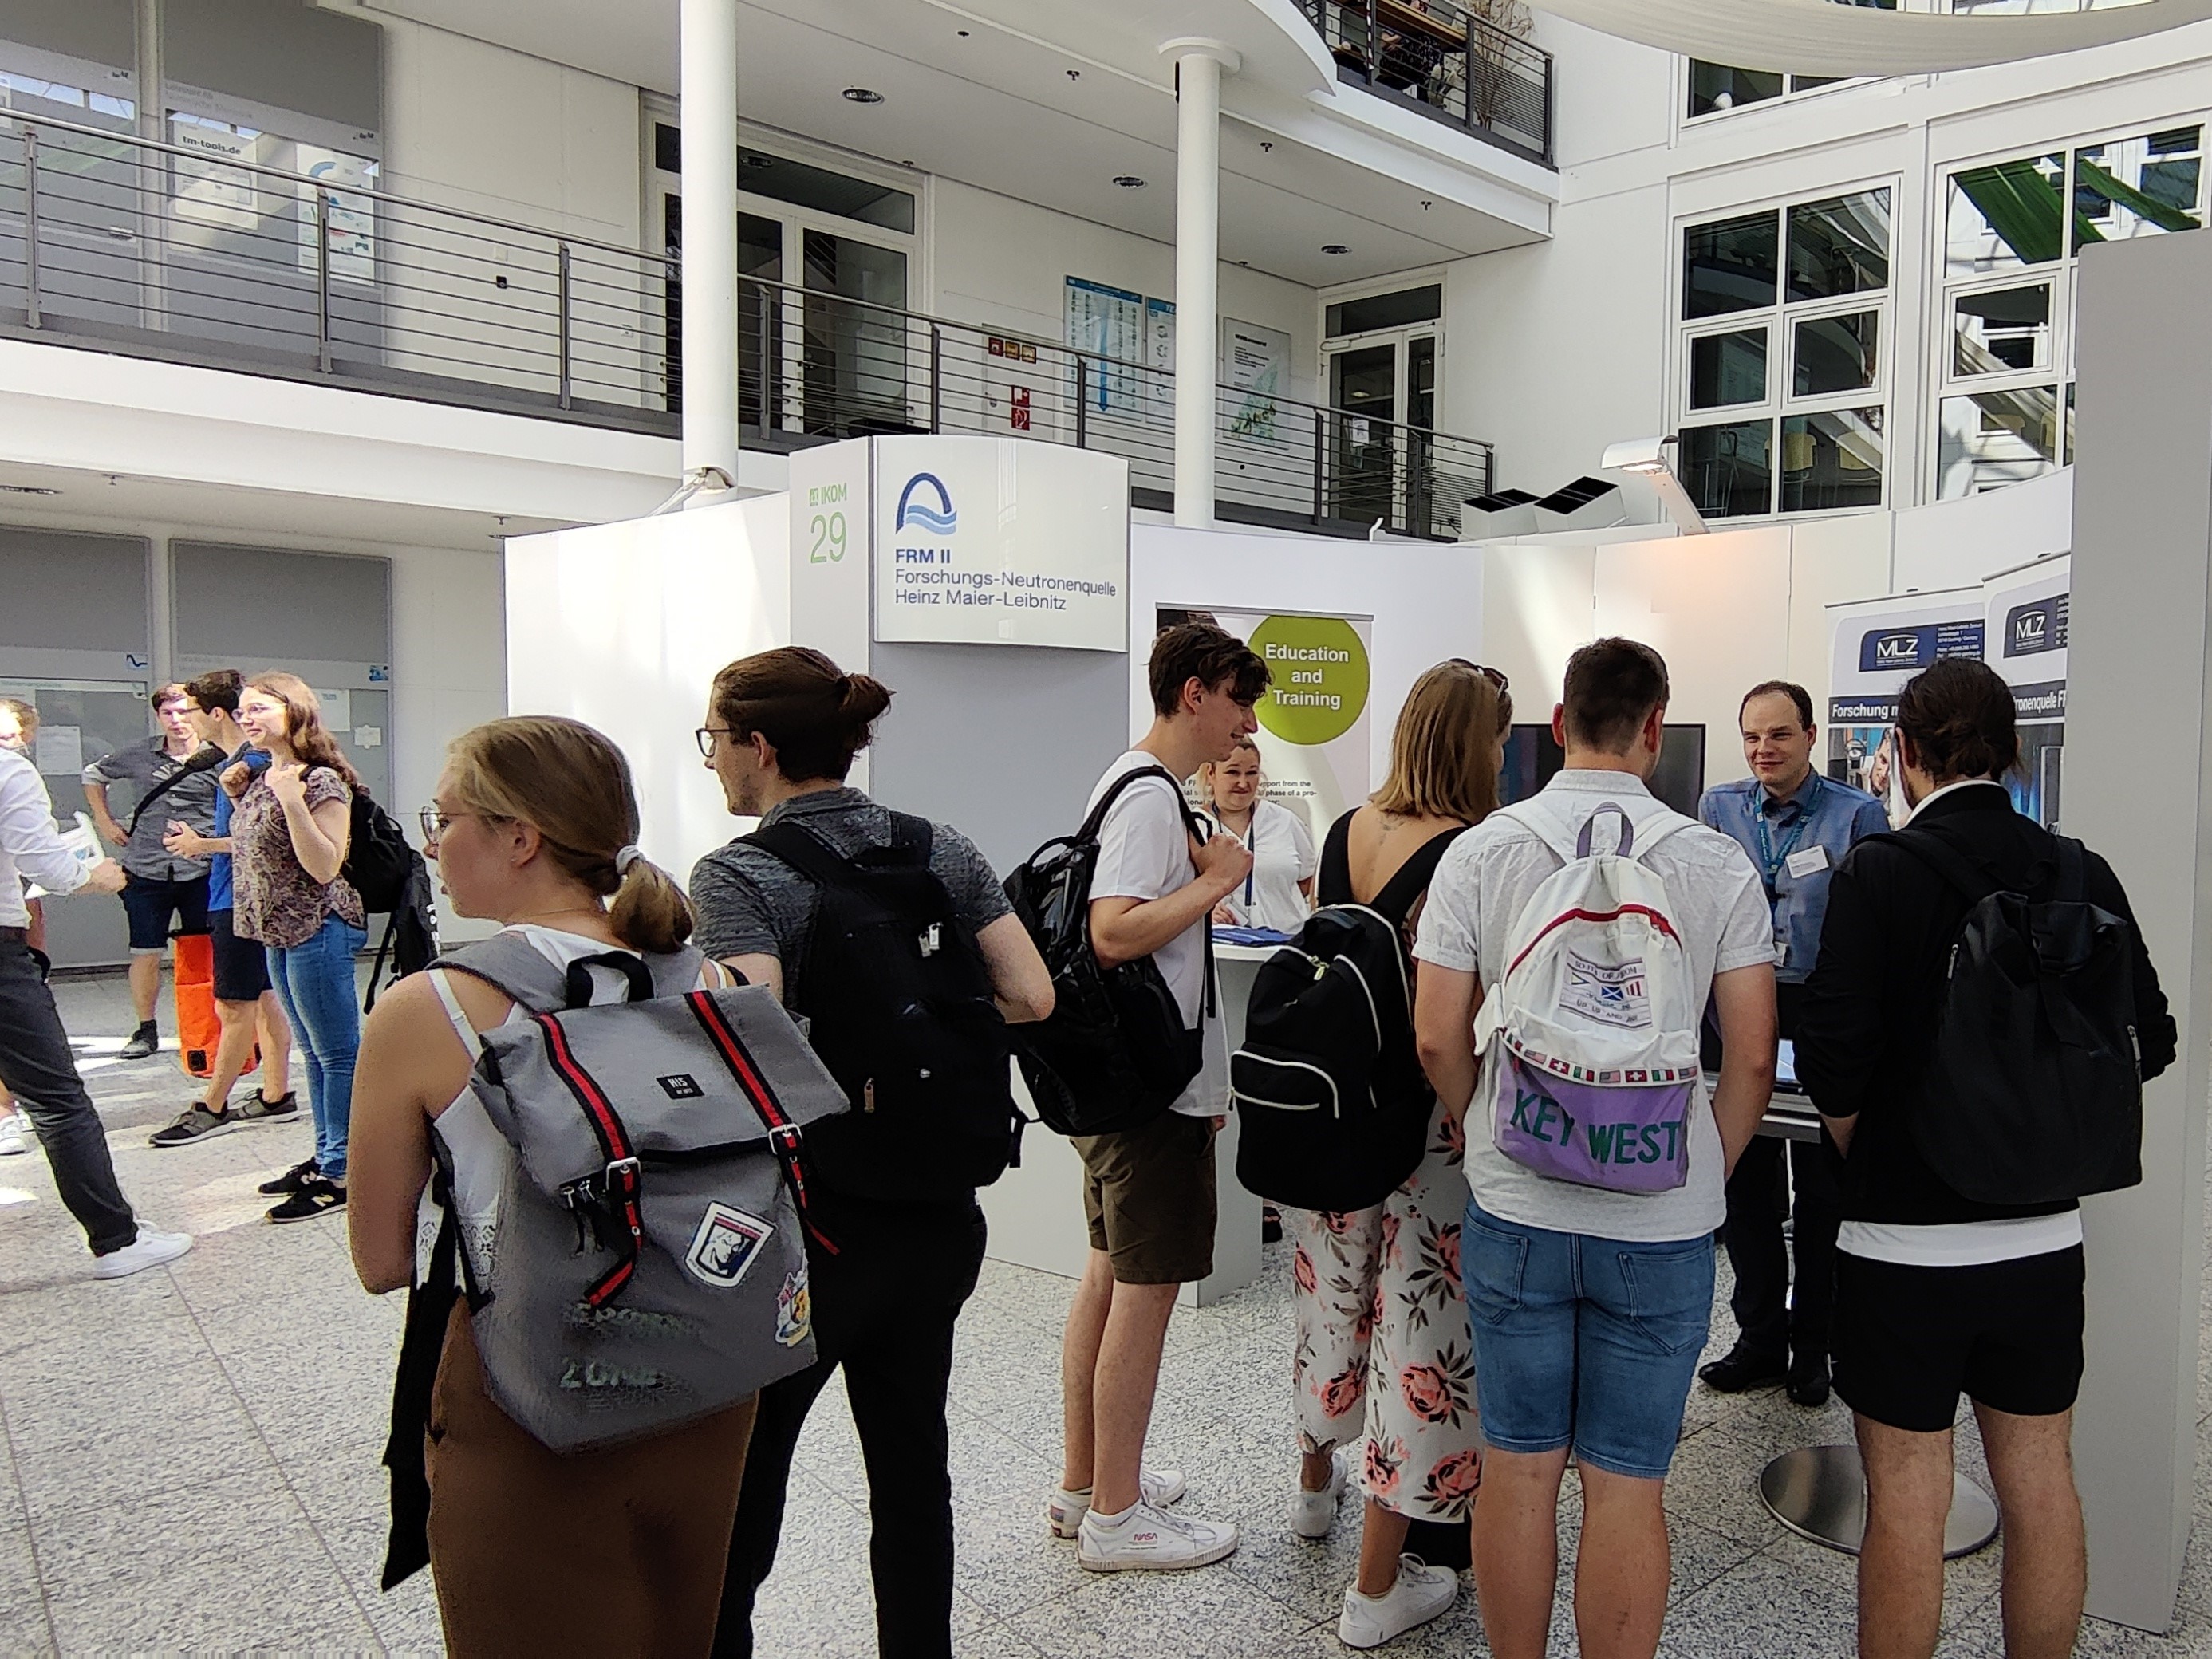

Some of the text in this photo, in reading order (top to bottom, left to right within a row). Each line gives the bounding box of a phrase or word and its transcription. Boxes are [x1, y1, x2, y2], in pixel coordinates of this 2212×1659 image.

[182, 135, 242, 155] tm-tools.de
[821, 482, 847, 505] IKOM
[810, 511, 847, 564] 29
[895, 548, 951, 564] FRM II
[895, 569, 1117, 597] Forschungs-Neutronenquelle
[895, 589, 1067, 611] Heinz Maier-Leibnitz
[2016, 615, 2046, 640] MLZ
[1265, 643, 1350, 663] Education
[1876, 638, 1918, 657] MLZ
[1291, 668, 1323, 684] and
[1272, 689, 1342, 711] Training
[1832, 703, 1889, 719] Forschung
[1265, 789, 1286, 798] phase
[1509, 1088, 1682, 1164] KEY WEST
[1134, 1531, 1158, 1541] NASA
